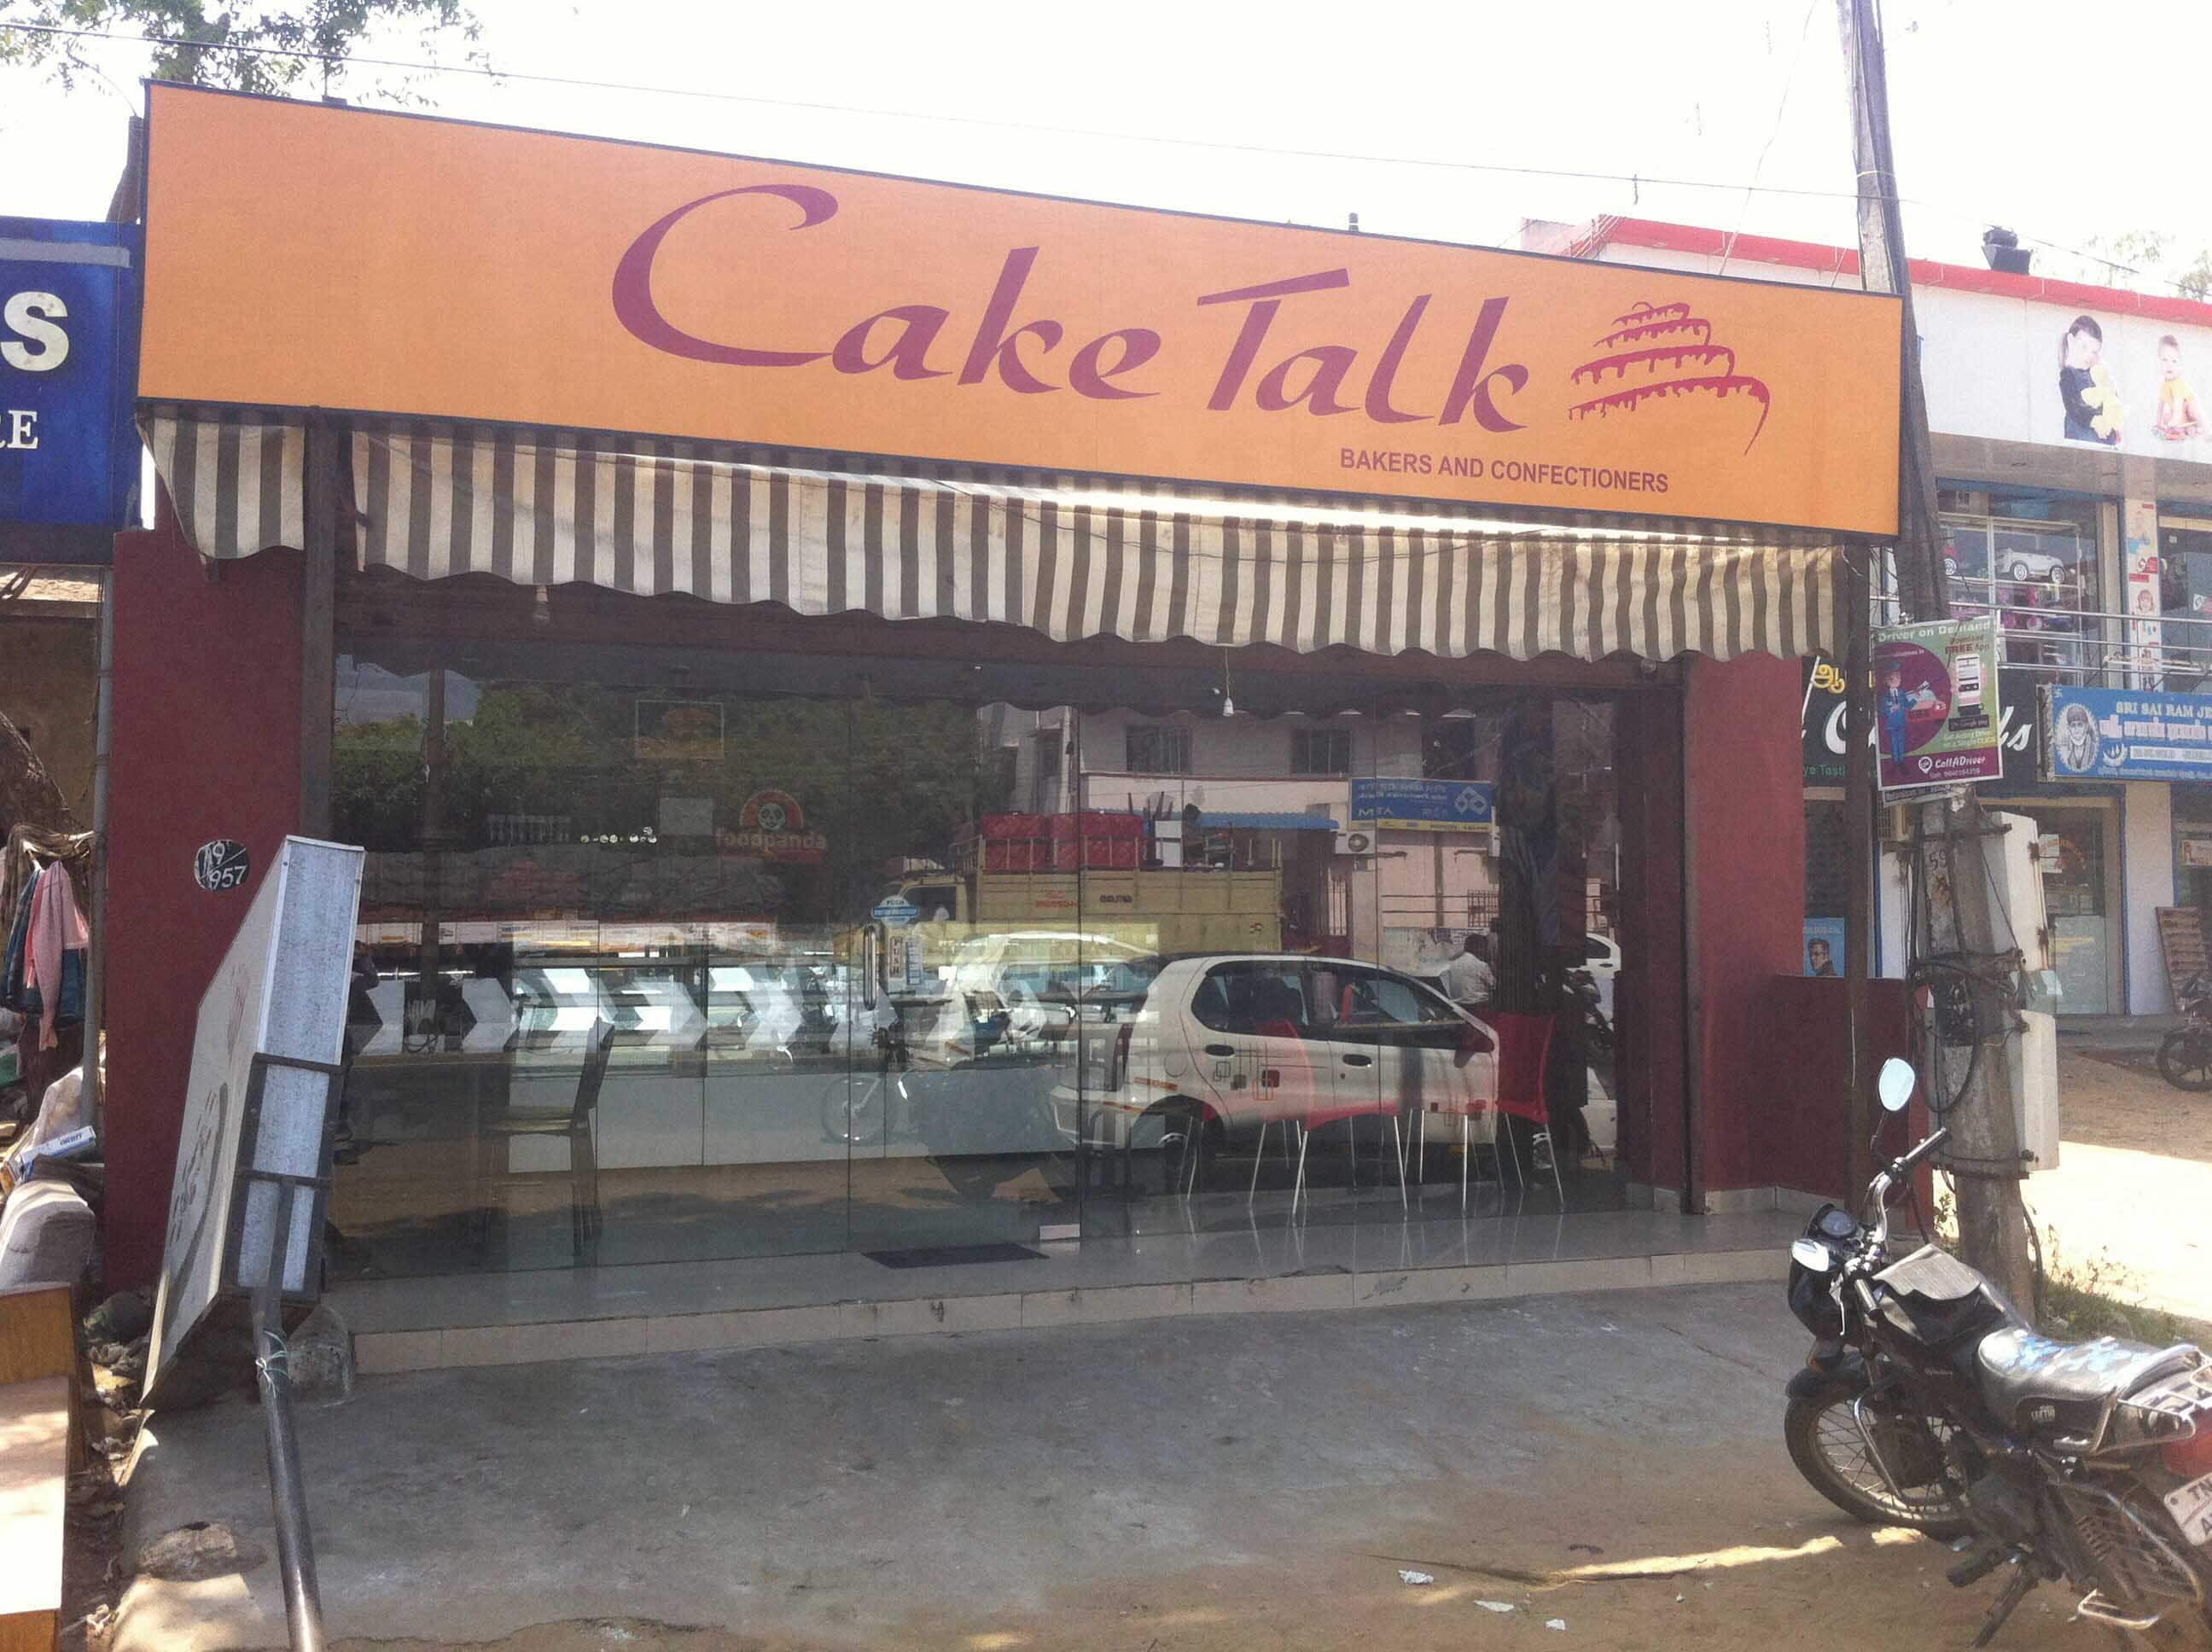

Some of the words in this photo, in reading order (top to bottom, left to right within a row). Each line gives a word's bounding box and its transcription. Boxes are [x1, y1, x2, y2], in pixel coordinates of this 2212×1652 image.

[612, 184, 1161, 399] Cake
[1197, 268, 1528, 432] Talk
[1340, 448, 1432, 475] BAKERS
[1438, 456, 1484, 479] AND
[1491, 459, 1668, 493] CONFECTIONERS
[1878, 631, 1914, 642] Driver
[1918, 627, 1935, 637] on
[2116, 701, 2138, 715] SRI
[2141, 702, 2162, 716] SAI
[2166, 704, 2193, 718] RAM
[715, 826, 827, 852] foodpanda
